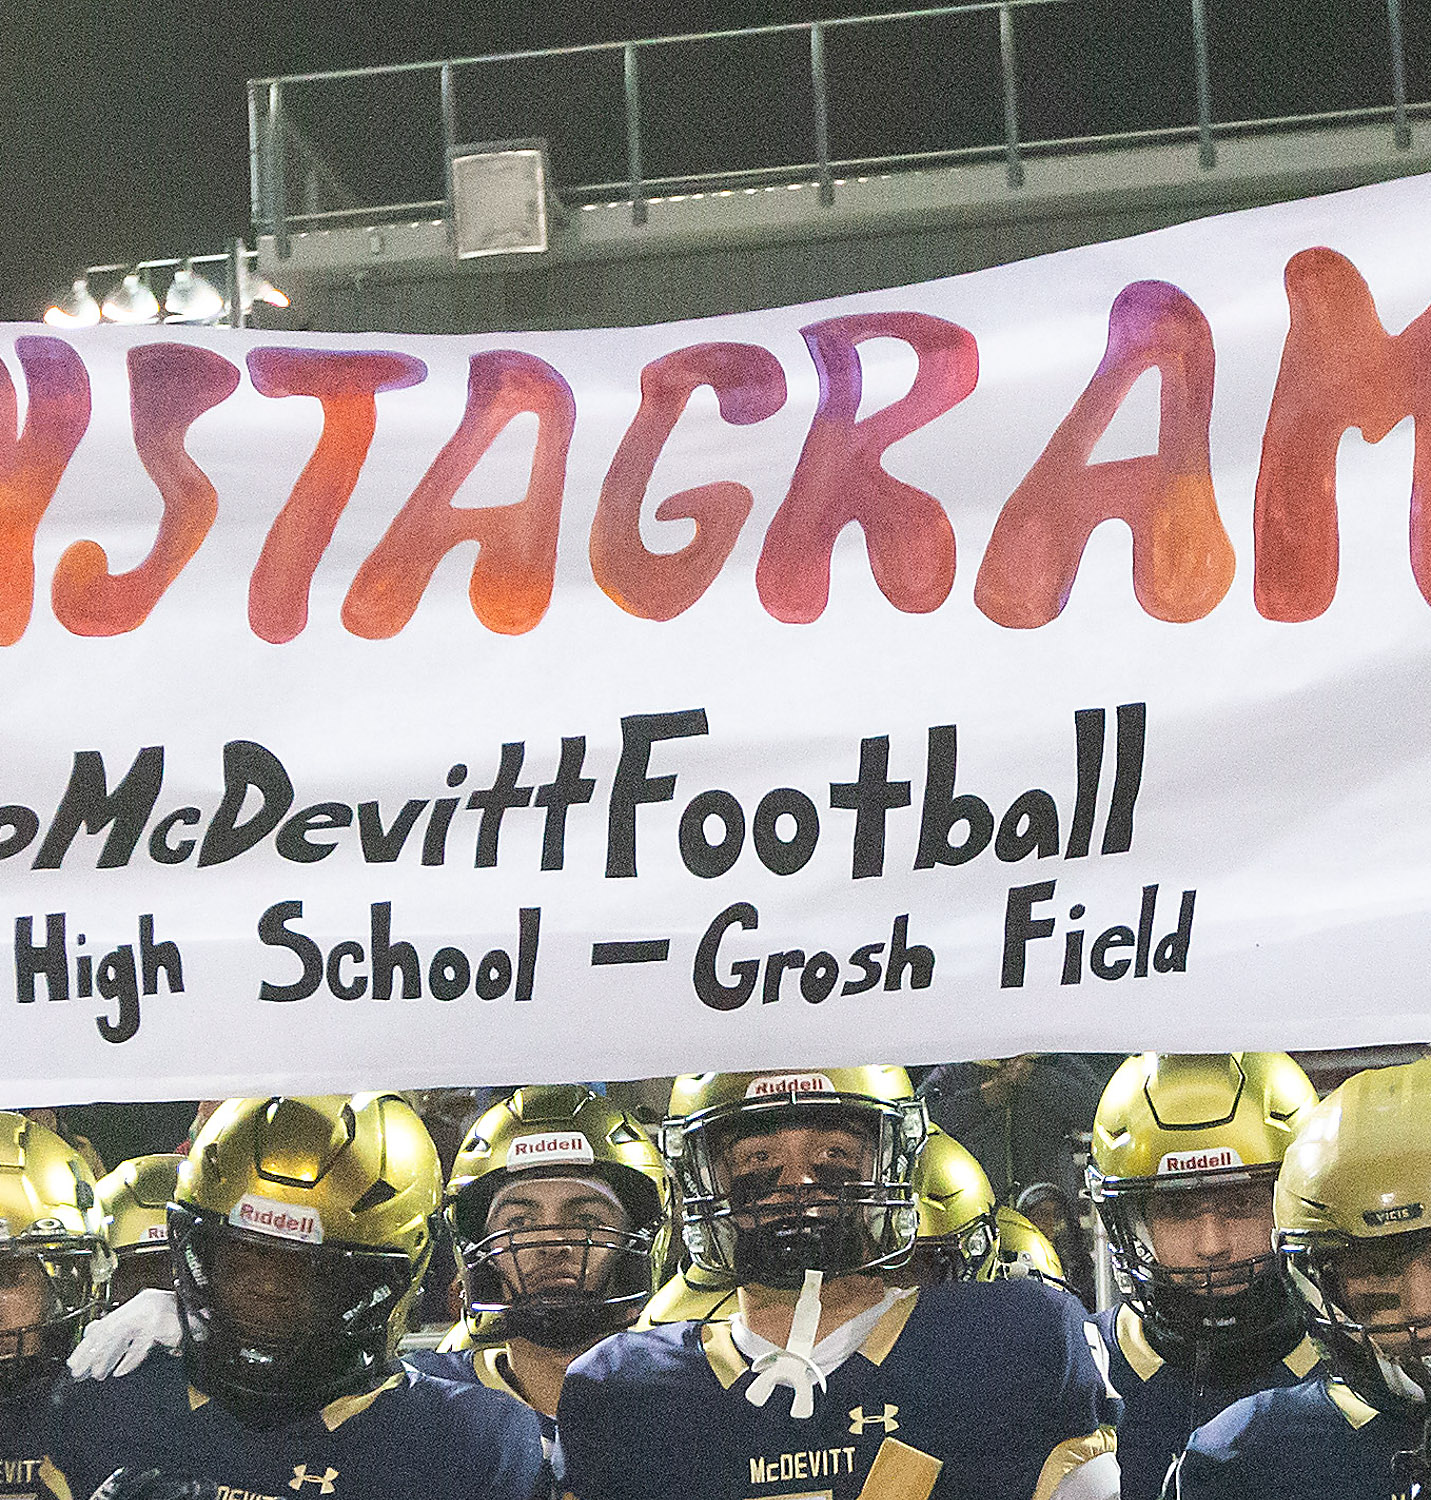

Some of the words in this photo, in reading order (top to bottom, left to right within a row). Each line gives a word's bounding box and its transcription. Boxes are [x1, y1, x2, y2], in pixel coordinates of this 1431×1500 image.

[14, 911, 185, 1044] High
[257, 900, 542, 1003] School
[692, 902, 936, 1011] Grosh
[1000, 879, 1197, 989] Field
[515, 1137, 584, 1156] Riddell
[1166, 1151, 1232, 1171] Riddell
[239, 1203, 314, 1234] Riddell
[749, 1446, 856, 1484] McDEVITT
